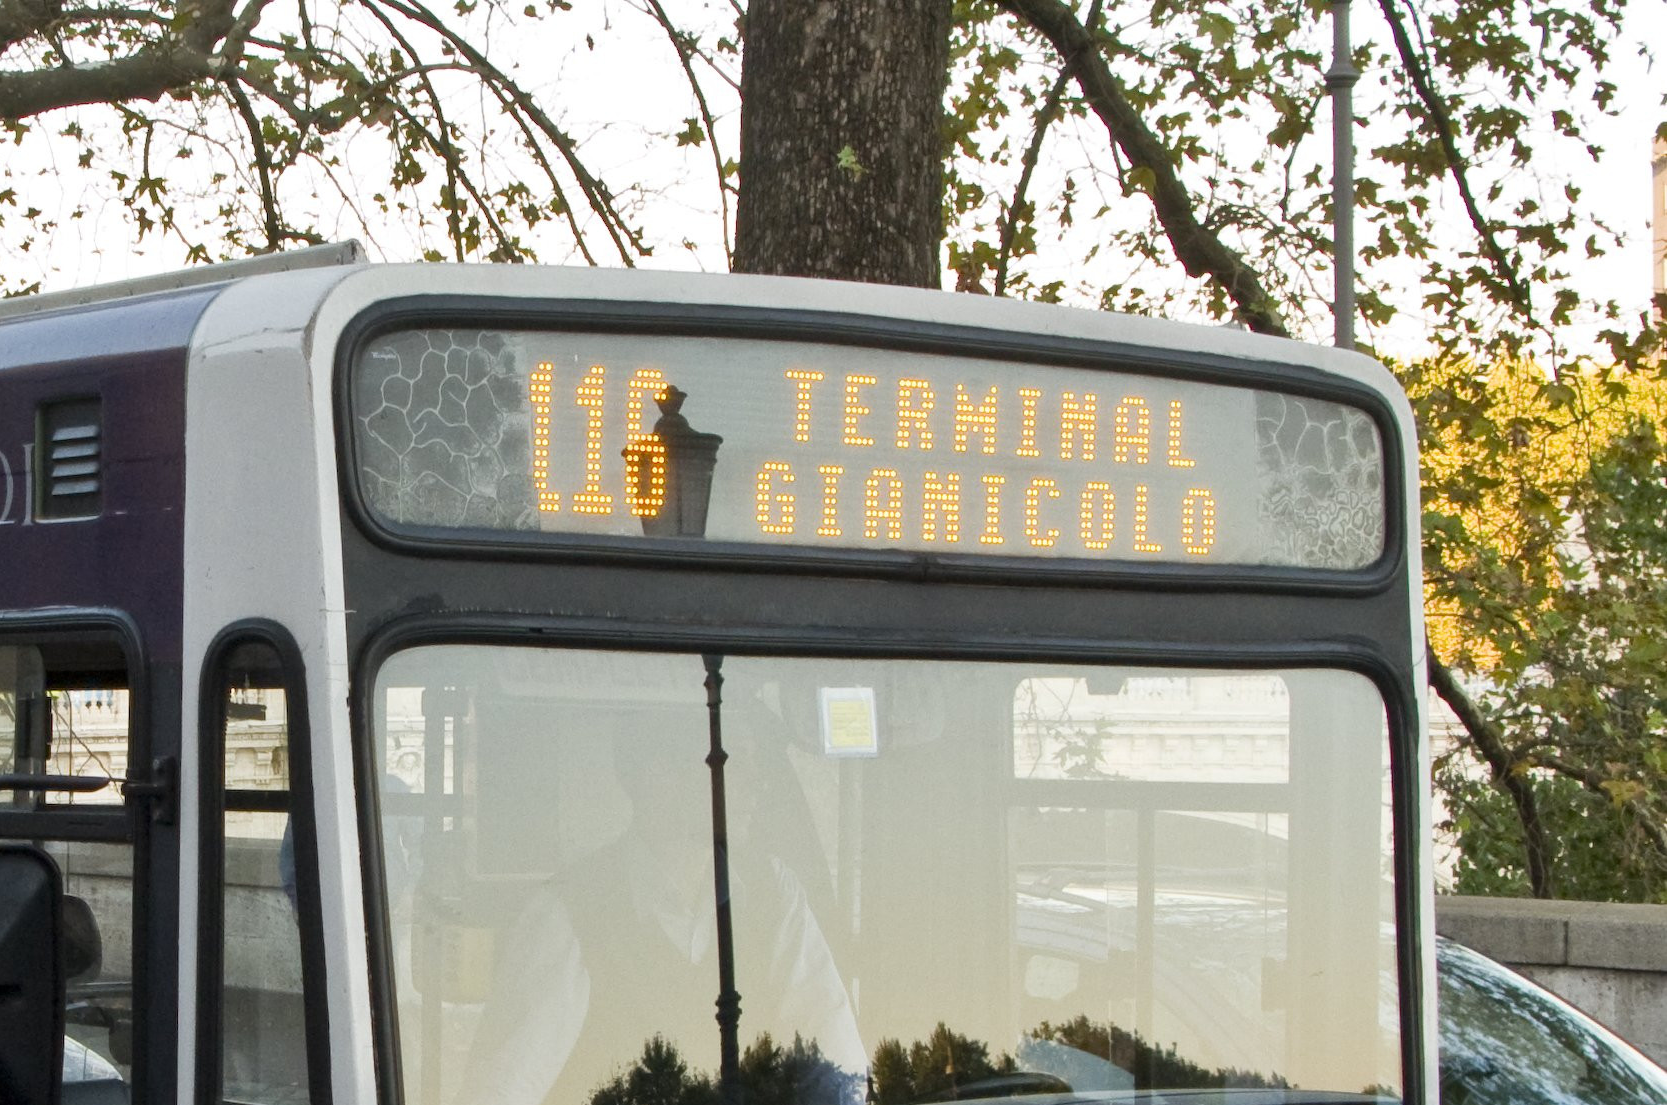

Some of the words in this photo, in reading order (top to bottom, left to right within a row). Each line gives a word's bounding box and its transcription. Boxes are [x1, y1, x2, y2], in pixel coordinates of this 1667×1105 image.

[530, 362, 668, 516] 116
[785, 369, 1196, 467] TERMINAL
[756, 461, 1215, 555] GIANICOLO
